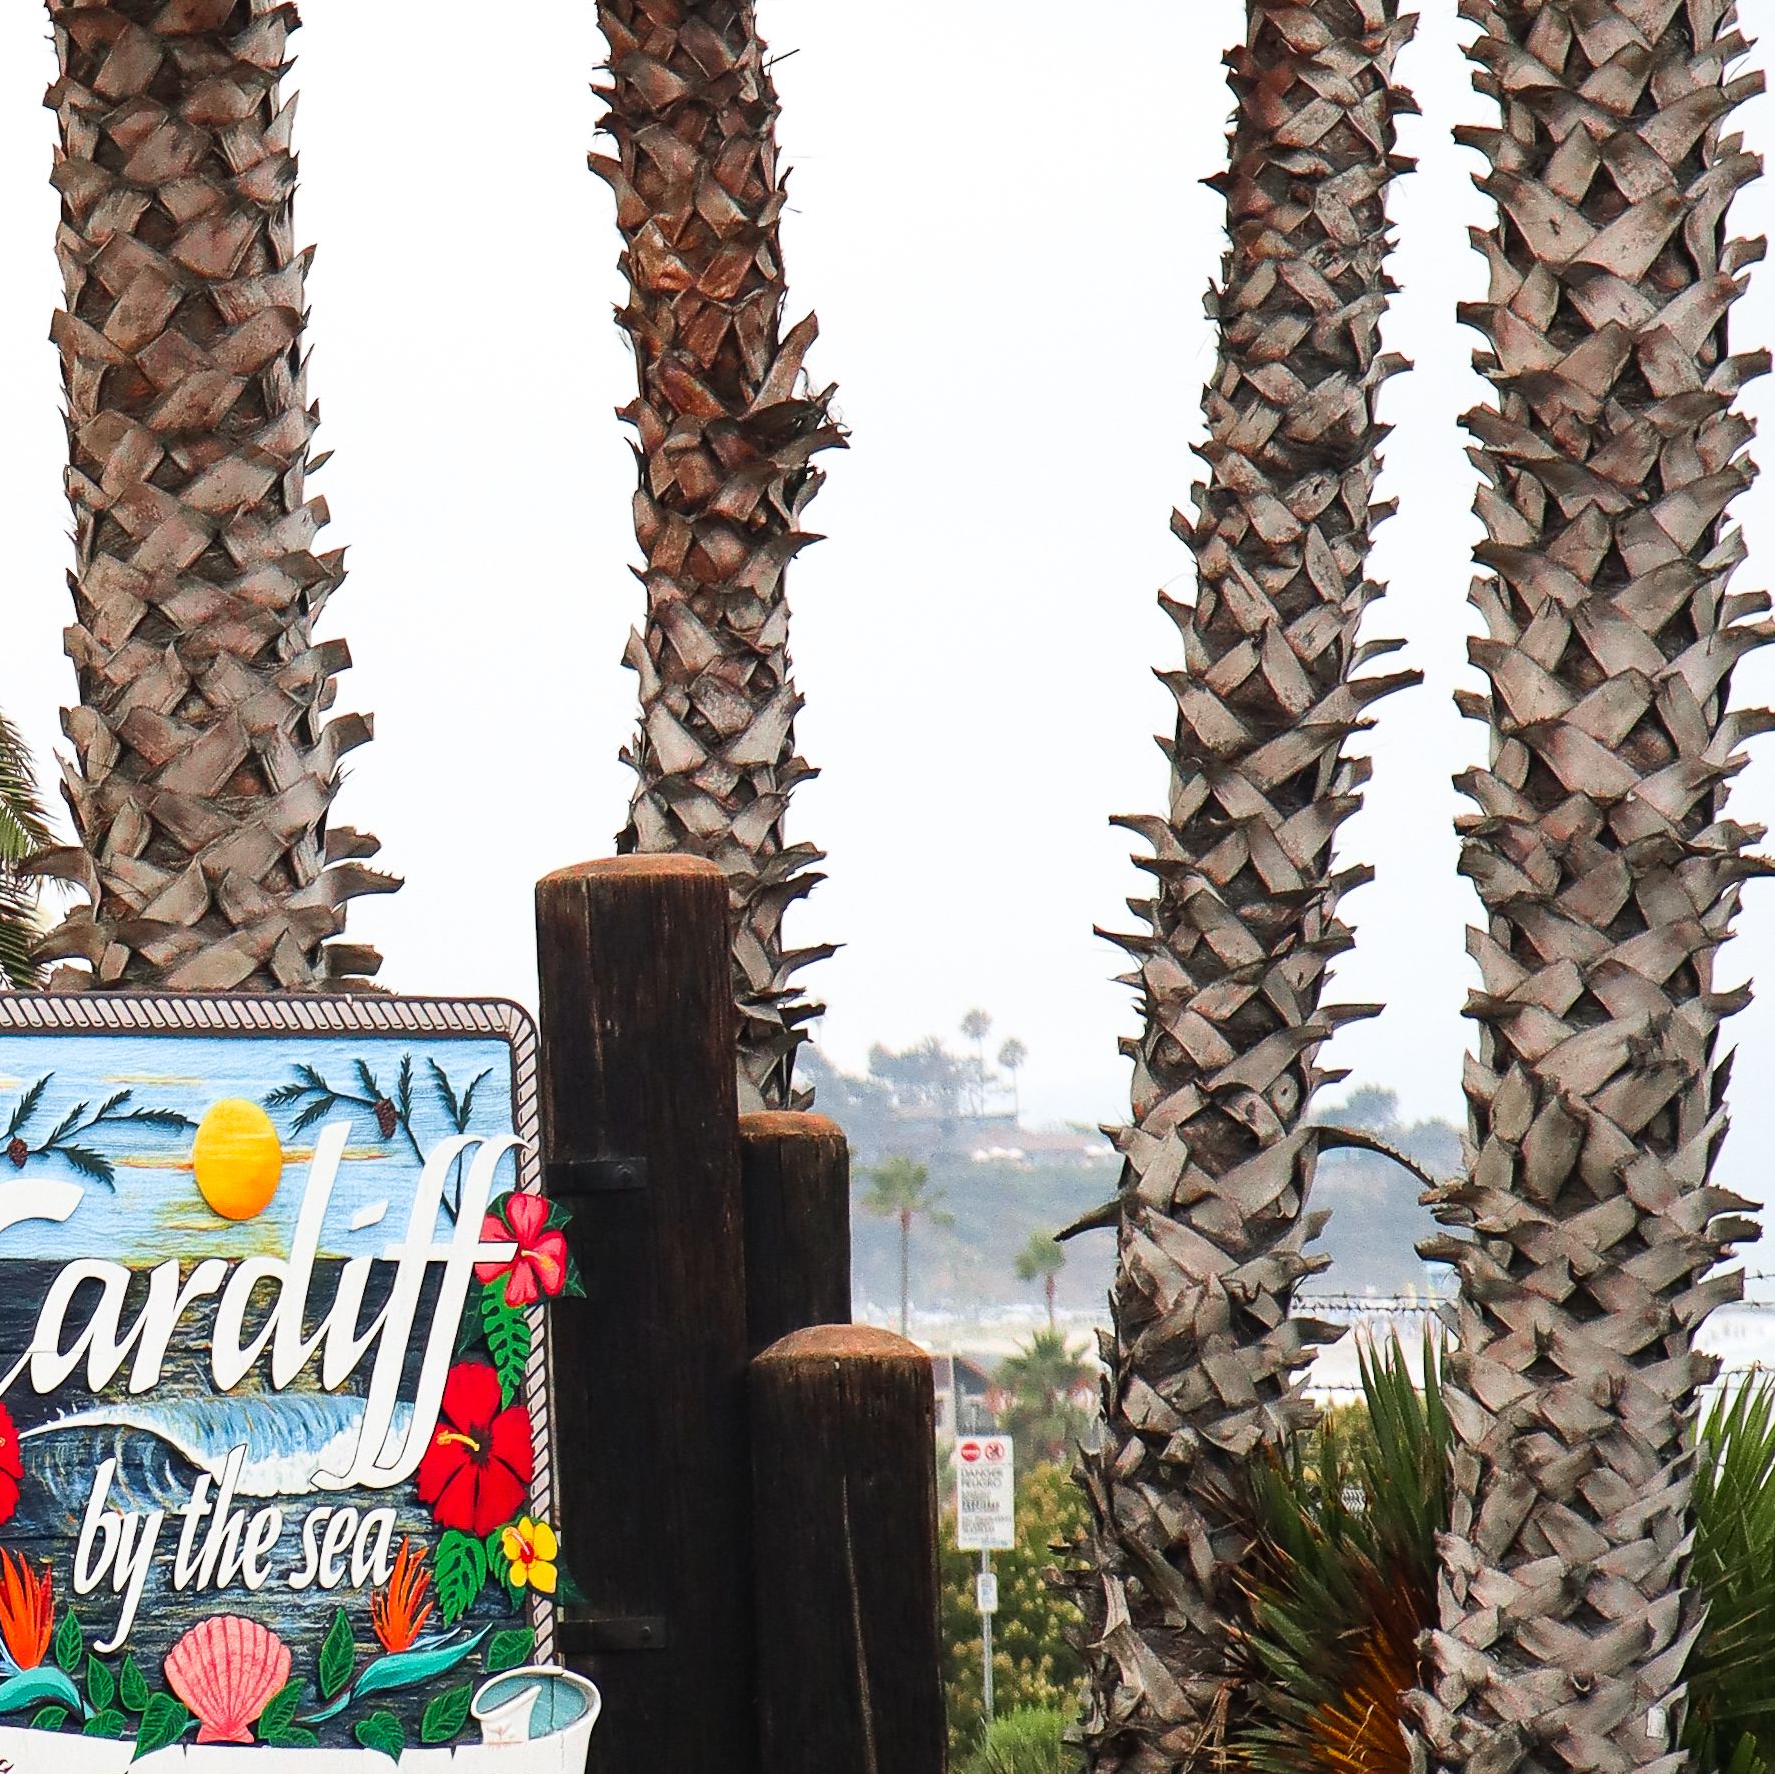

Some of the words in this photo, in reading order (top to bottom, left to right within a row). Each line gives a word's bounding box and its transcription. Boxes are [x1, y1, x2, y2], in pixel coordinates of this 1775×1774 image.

[72, 1458, 167, 1653] by
[175, 1445, 282, 1592] the
[288, 1498, 398, 1590] sea
